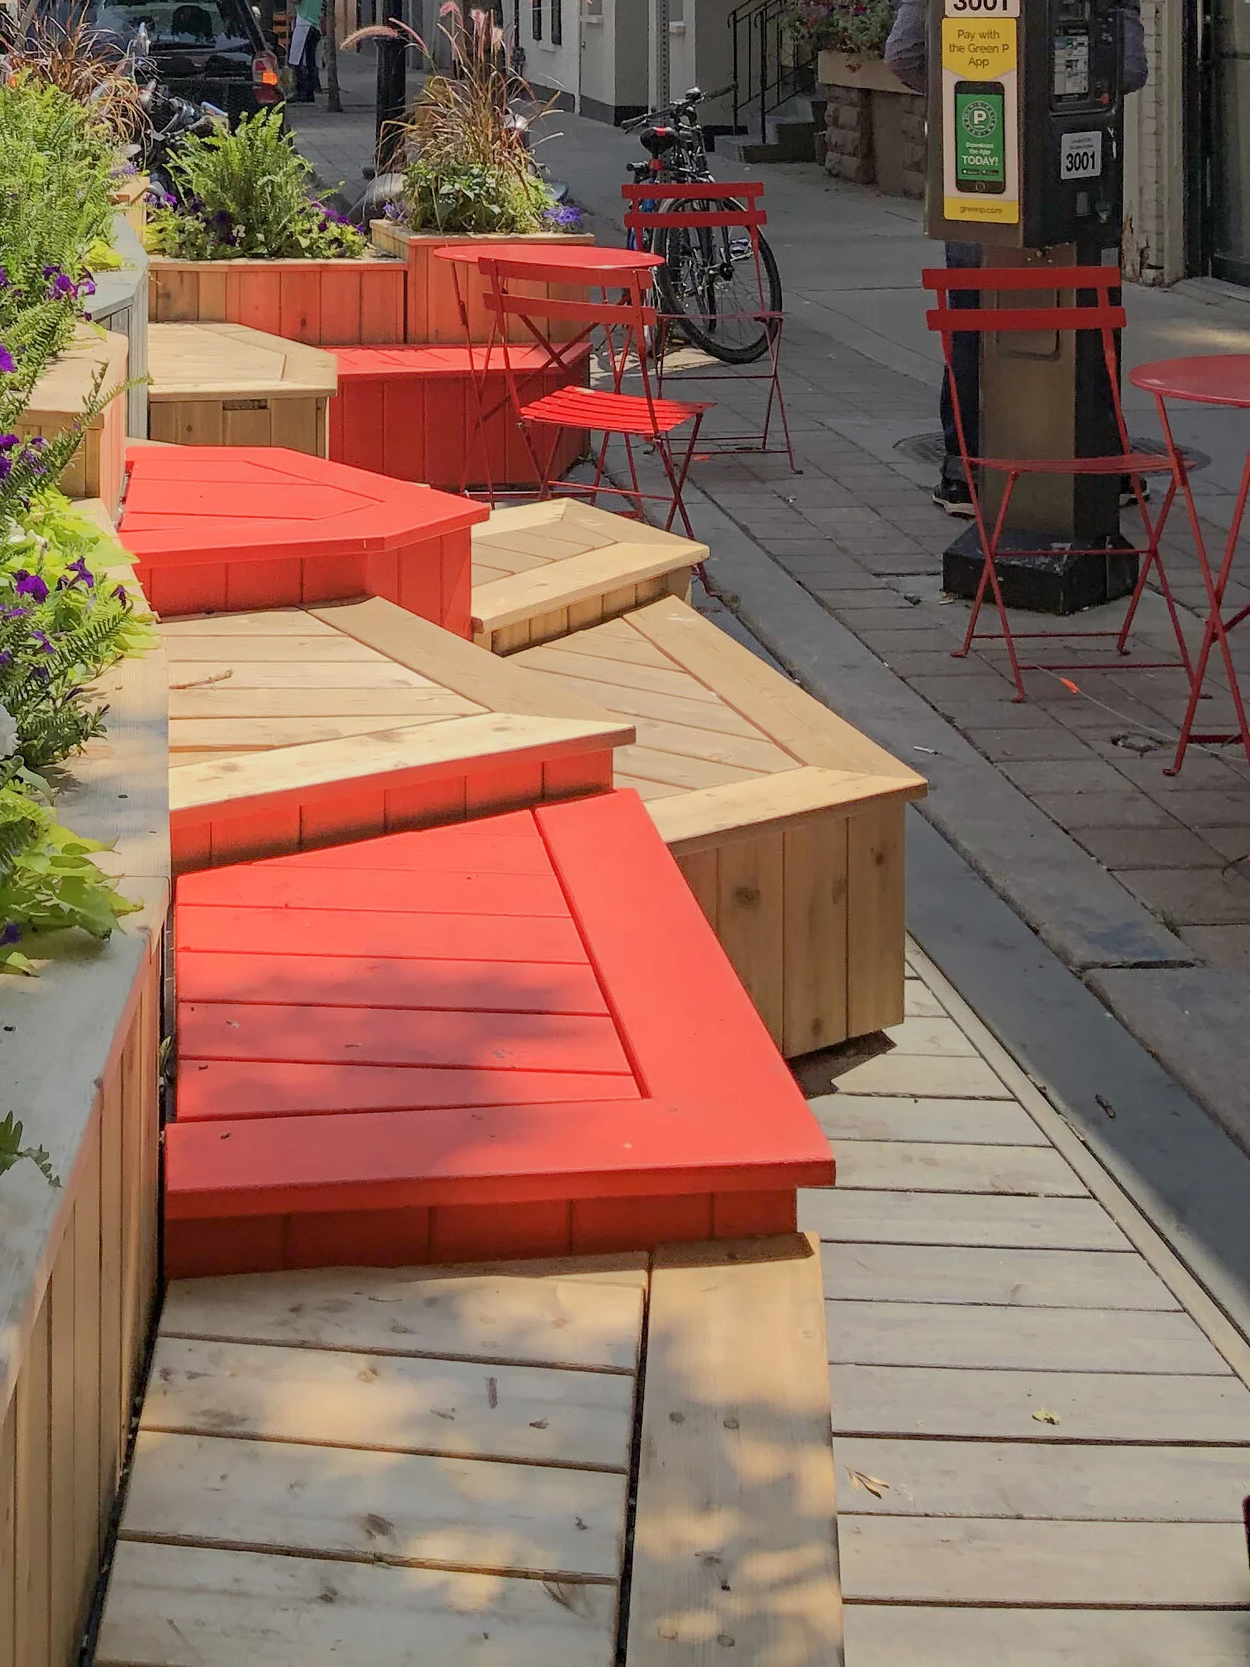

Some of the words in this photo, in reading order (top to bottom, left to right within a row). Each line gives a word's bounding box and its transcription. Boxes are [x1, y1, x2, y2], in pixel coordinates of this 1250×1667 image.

[957, 29, 976, 42] Pay
[979, 29, 1000, 39] with
[949, 43, 965, 53] the
[968, 43, 999, 53] Green
[1002, 43, 1010, 53] P
[968, 57, 990, 69] App
[973, 110, 987, 125] P
[961, 155, 999, 166] TODAY!
[1065, 150, 1096, 172] 3001
